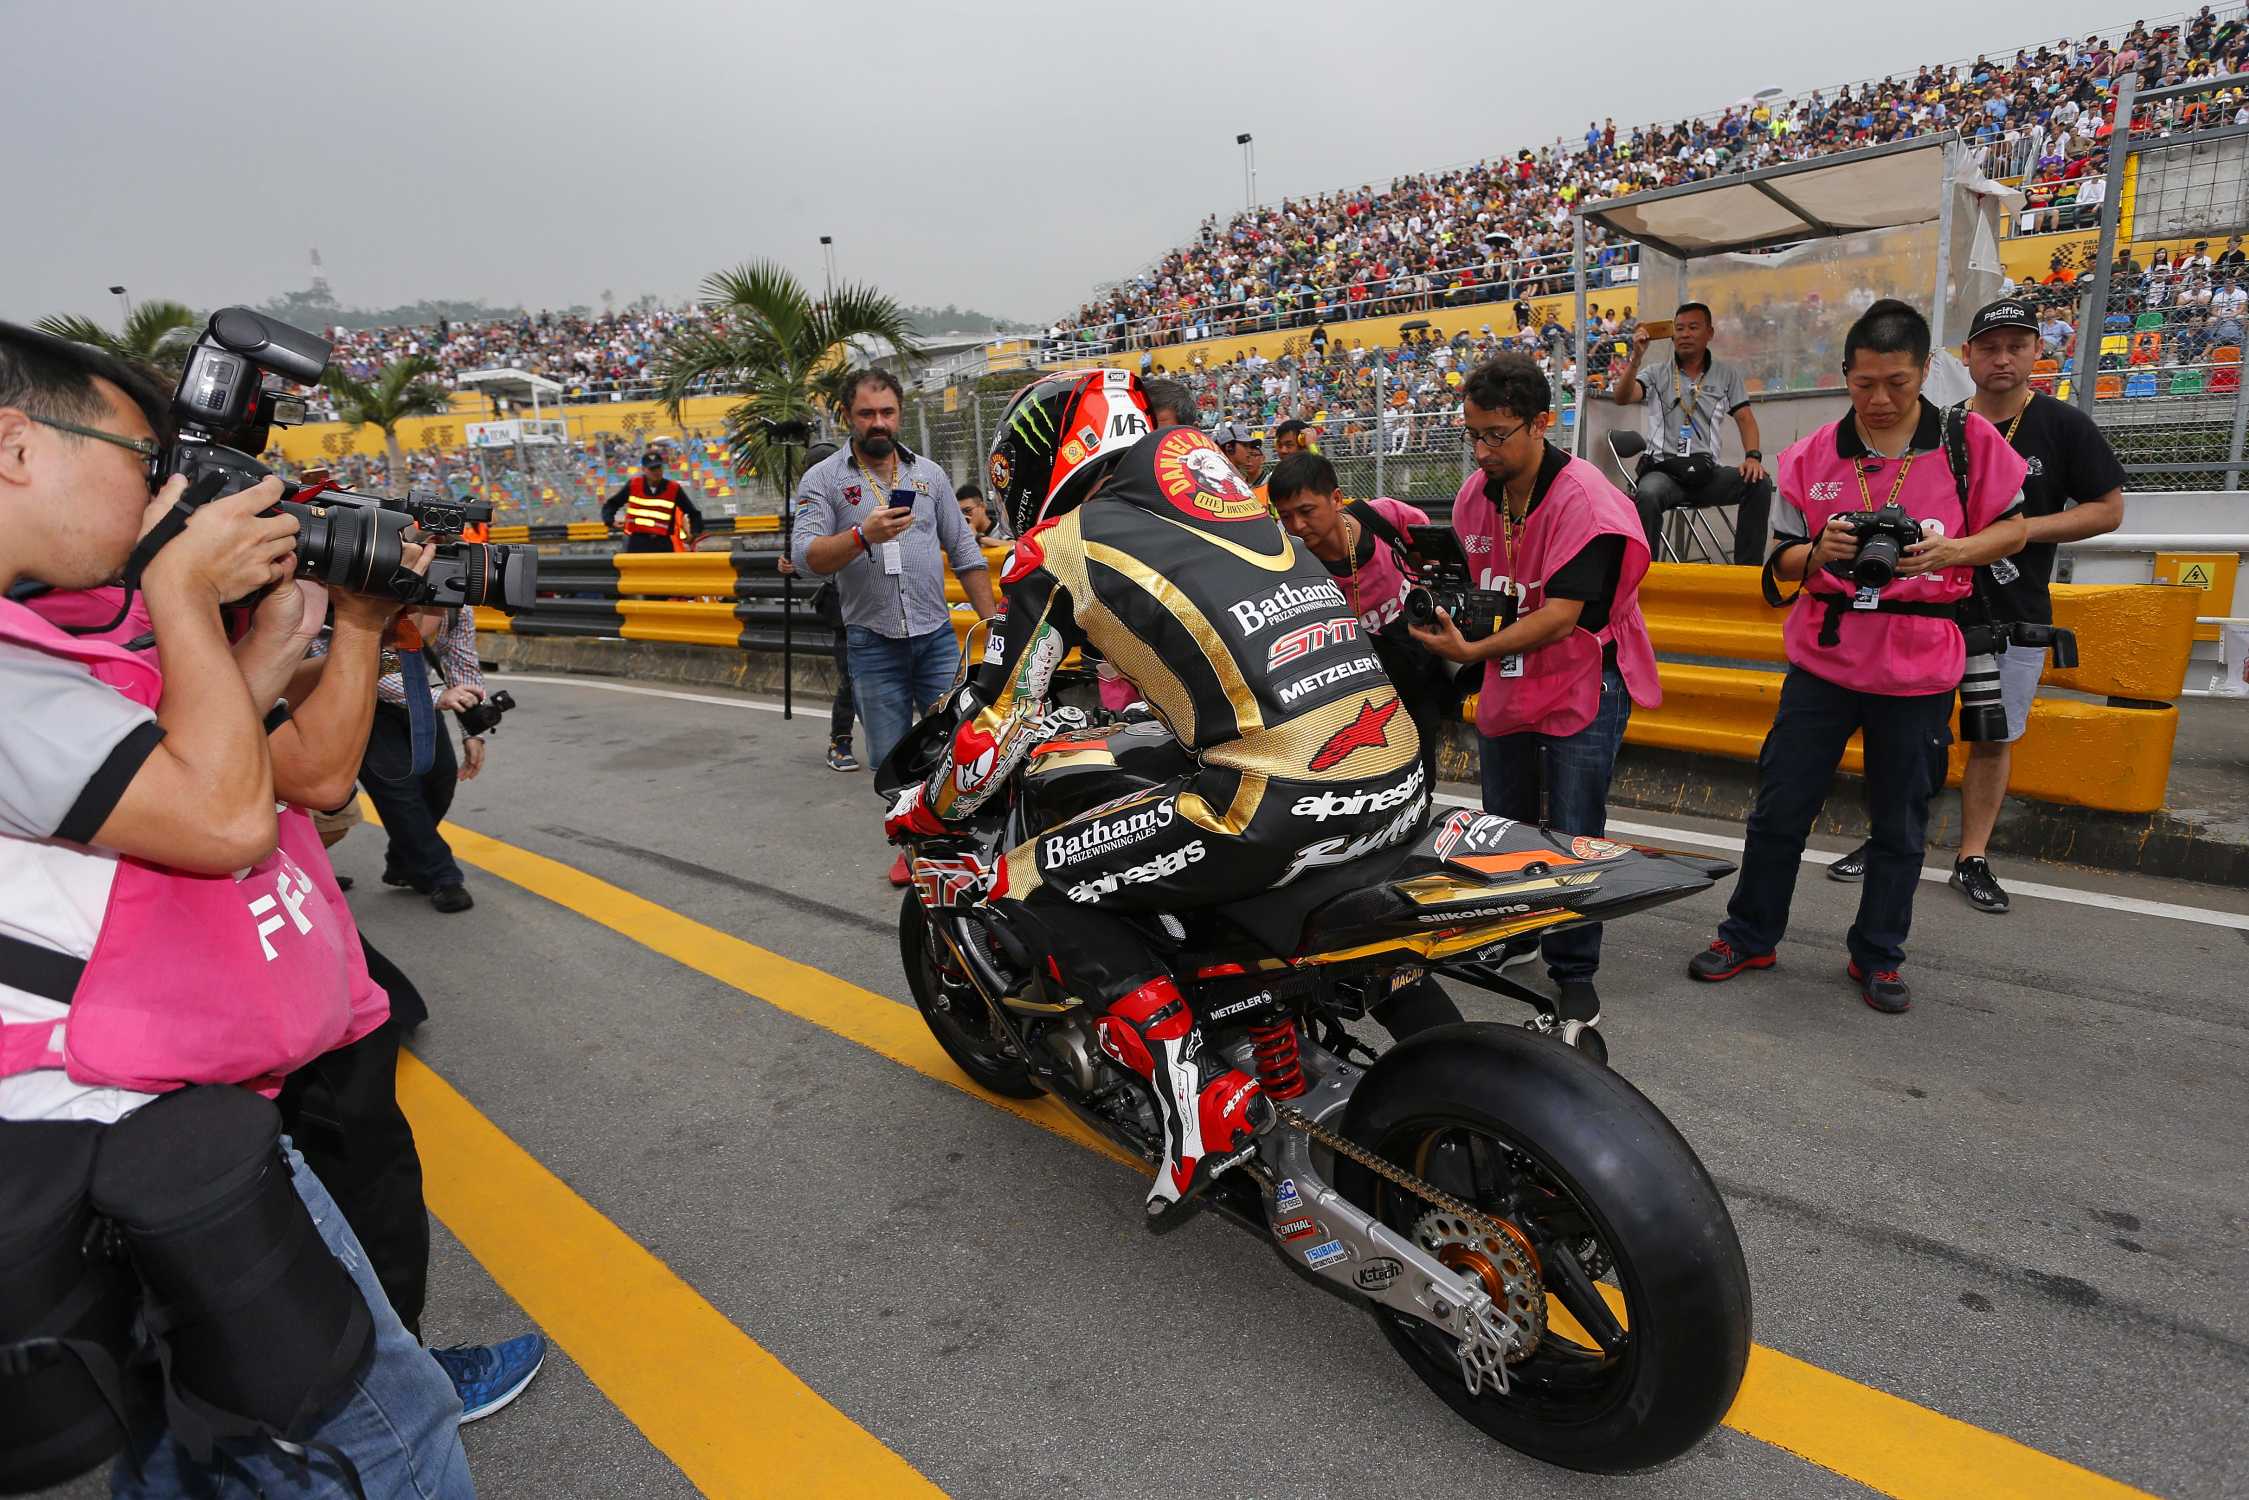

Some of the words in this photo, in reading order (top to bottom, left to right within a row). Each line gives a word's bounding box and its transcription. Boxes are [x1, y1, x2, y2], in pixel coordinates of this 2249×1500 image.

[1159, 433, 1193, 497] DANIEL
[1199, 494, 1220, 509] THE
[1227, 578, 1347, 637] Bathams
[1266, 617, 1359, 674] SMT
[1278, 657, 1376, 704] METZELER
[1044, 796, 1175, 870] Bathams
[1066, 834, 1134, 866] PRIZEWINNING
[1134, 825, 1157, 842] ALES
[1067, 839, 1206, 903] alpinestars
[1417, 903, 1531, 923] Silkolene
[1391, 968, 1424, 992] MACAU
[1210, 995, 1262, 1021] METZELER
[1305, 1241, 1342, 1261] TSUBAKI
